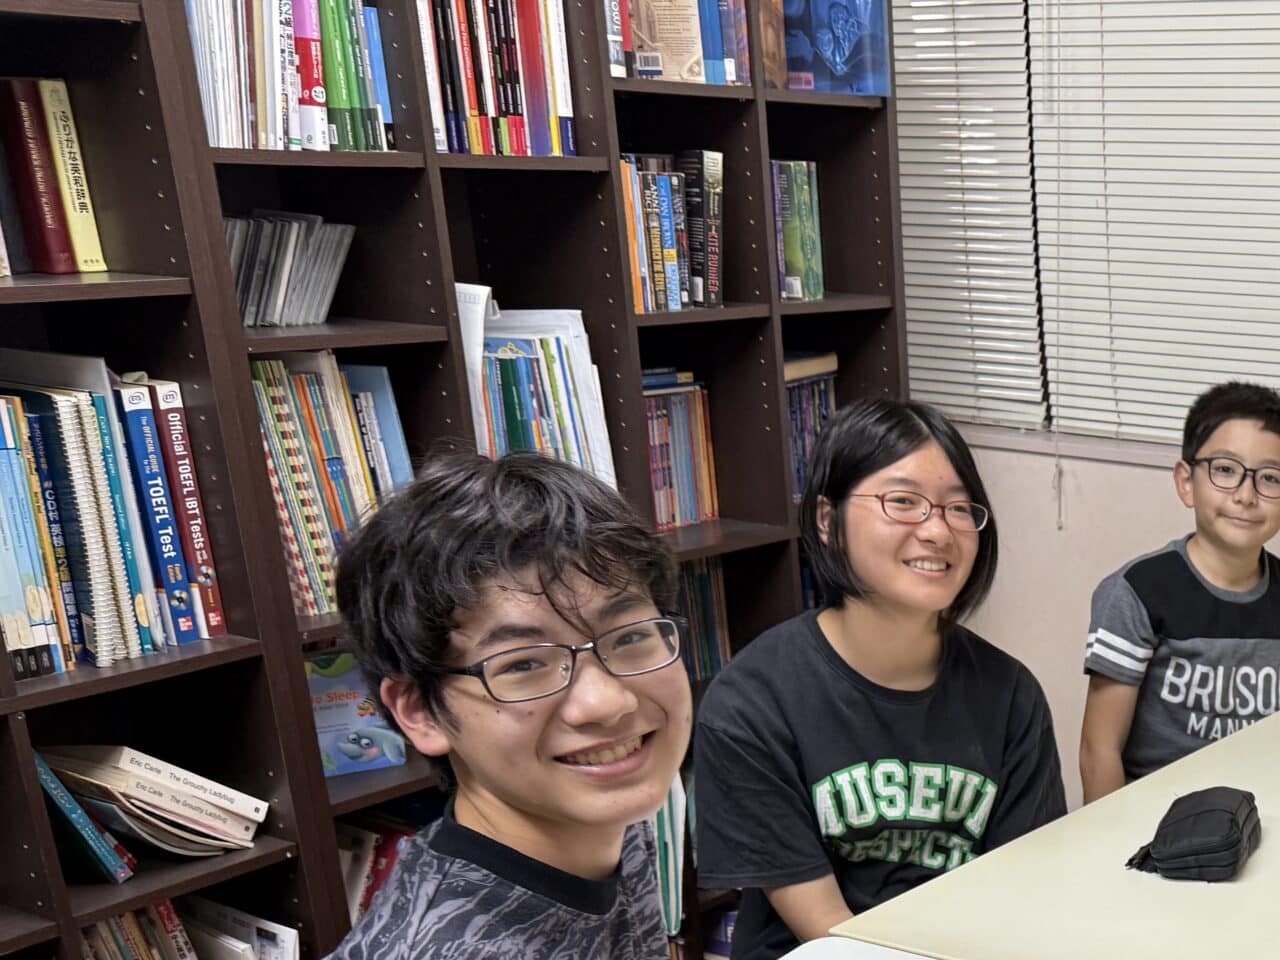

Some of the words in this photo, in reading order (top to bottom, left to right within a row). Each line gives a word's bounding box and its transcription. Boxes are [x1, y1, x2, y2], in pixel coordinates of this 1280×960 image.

[707, 231, 719, 254] KITE
[708, 254, 720, 292] RUNNER
[167, 412, 188, 455] Official
[177, 458, 196, 495] TOEFL
[147, 476, 170, 523] TOEFL
[158, 526, 177, 559] Test
[189, 520, 205, 549] Tests
[326, 690, 361, 703] Sleep
[130, 757, 143, 768] Eric
[144, 763, 162, 774] Carle
[169, 772, 181, 782] The
[136, 782, 147, 792] Eric
[148, 786, 163, 797] Carle
[169, 794, 181, 803] The
